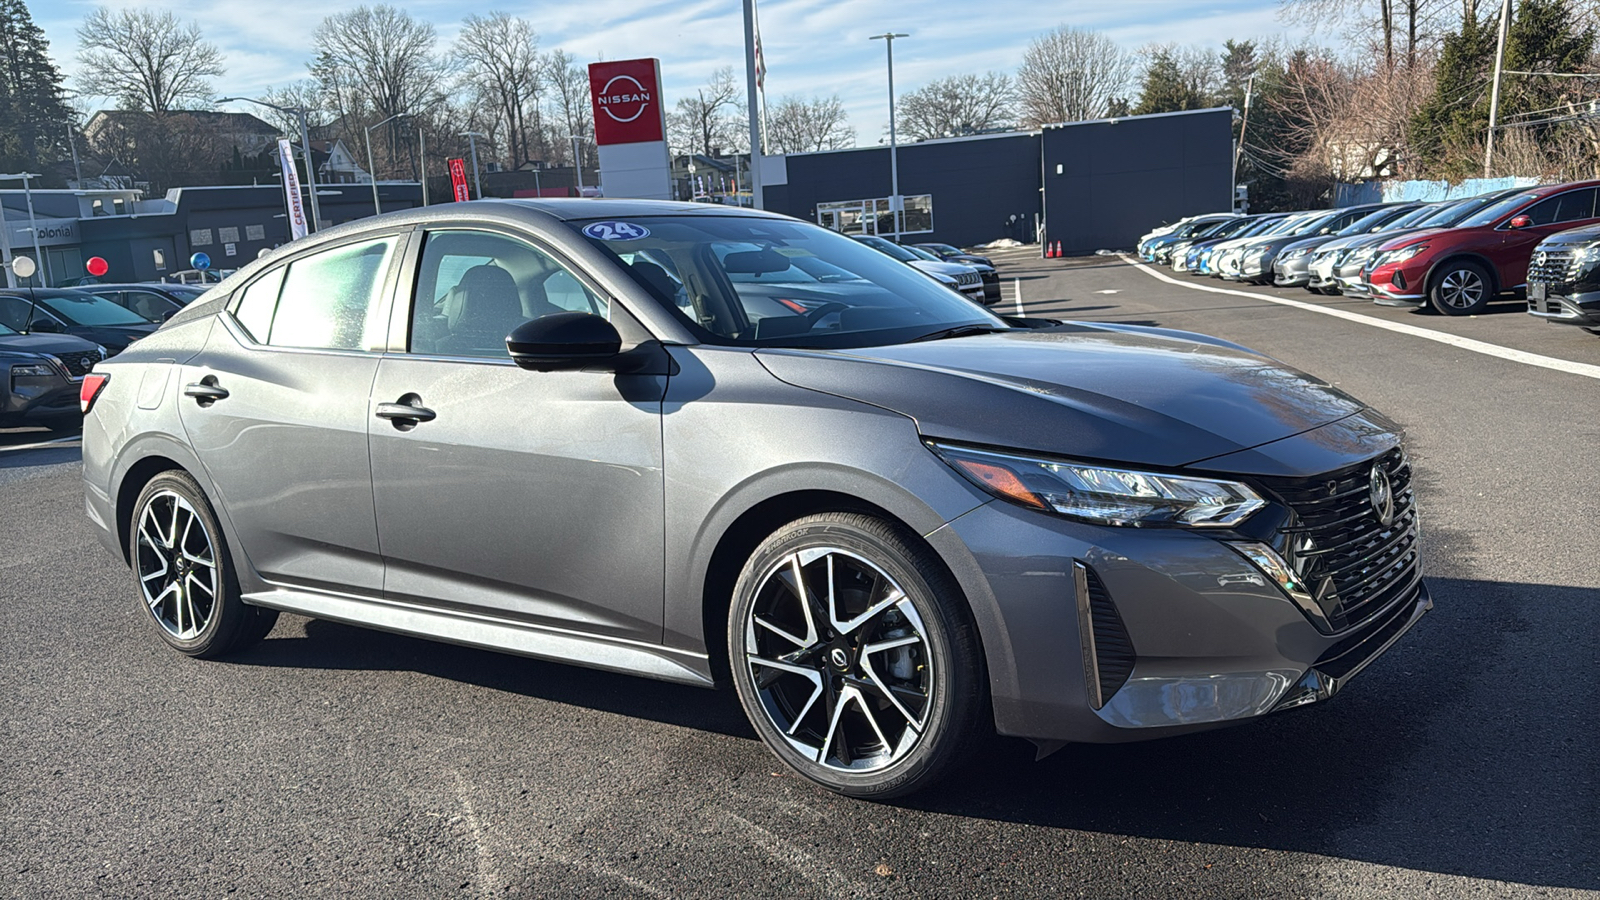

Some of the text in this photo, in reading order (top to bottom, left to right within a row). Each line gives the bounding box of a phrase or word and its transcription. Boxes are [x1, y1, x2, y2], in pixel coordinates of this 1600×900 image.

[598, 93, 650, 105] NISSAN
[288, 173, 303, 226] CERTIFIED
[593, 222, 639, 240] 24
